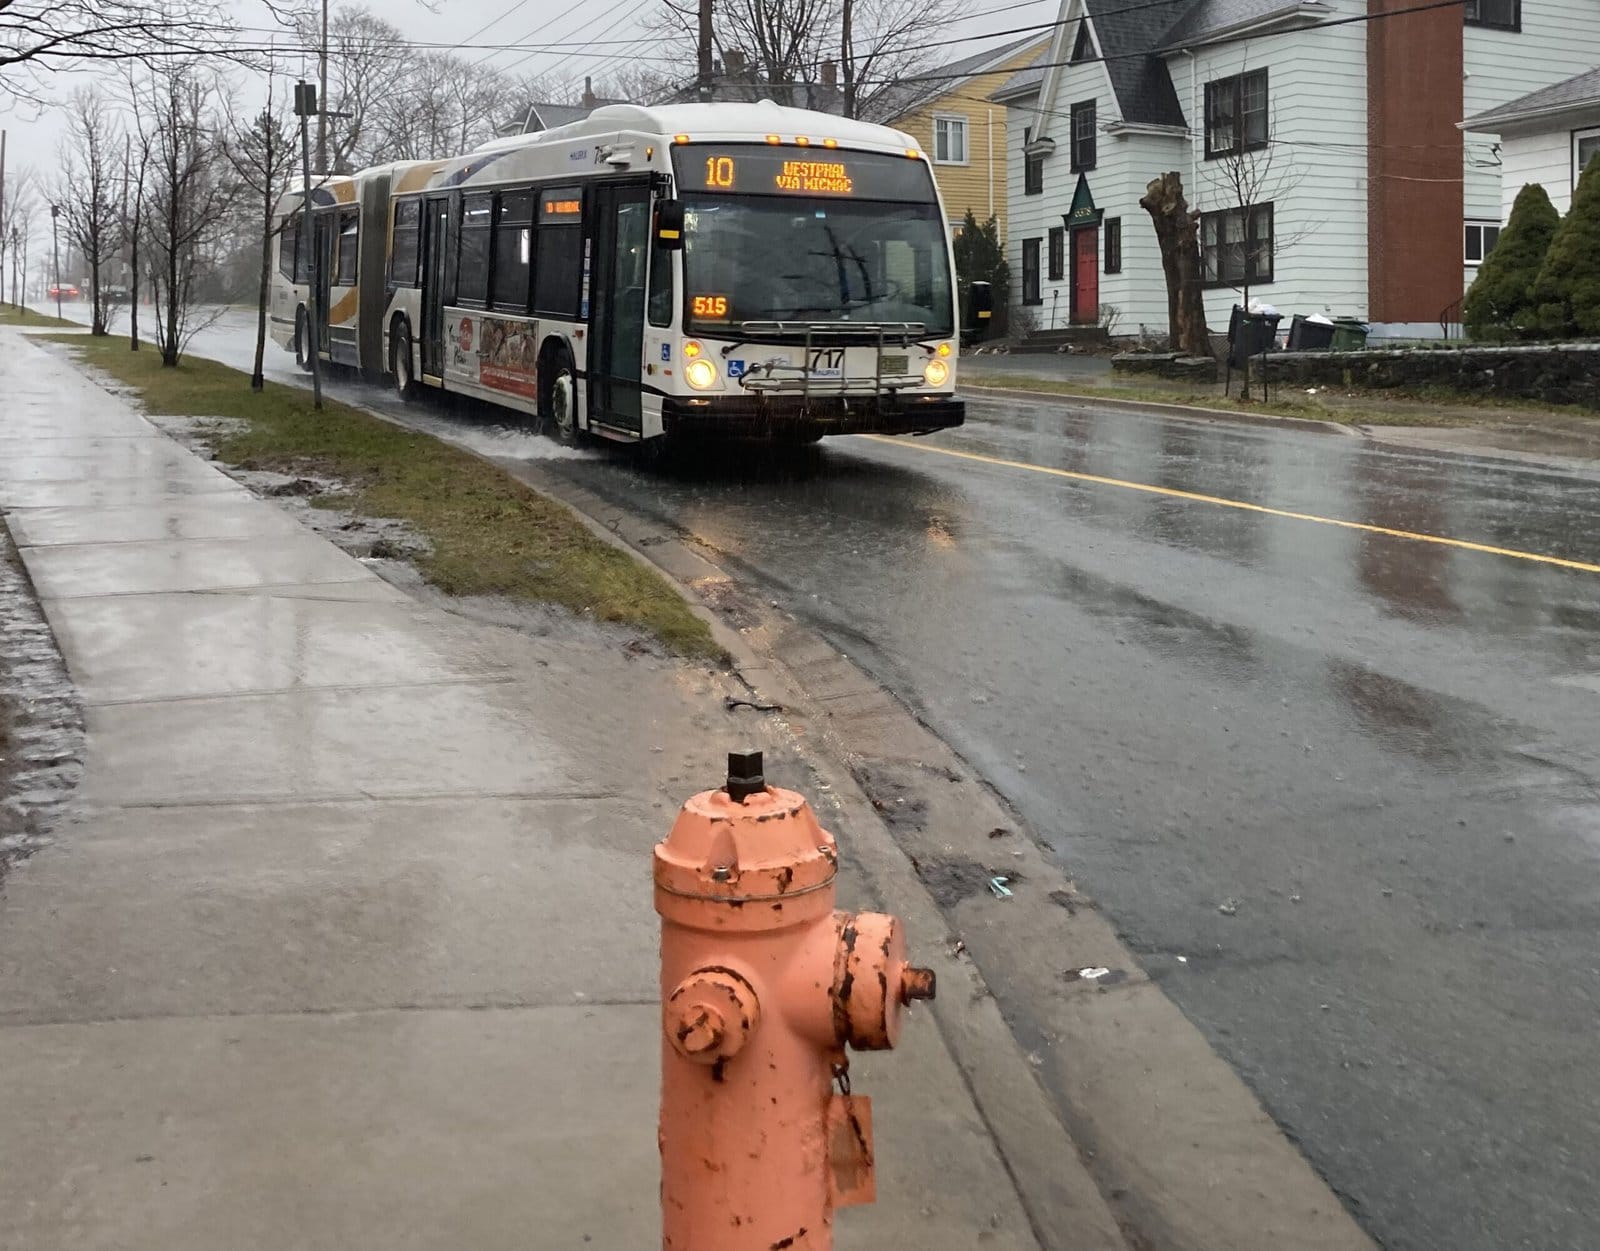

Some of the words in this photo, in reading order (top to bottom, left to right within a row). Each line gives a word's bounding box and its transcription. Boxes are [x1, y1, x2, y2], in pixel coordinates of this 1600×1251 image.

[705, 156, 735, 187] 10
[782, 161, 846, 178] WESTPHAL
[776, 175, 801, 191] VIA
[803, 177, 853, 193] MICMAC
[693, 296, 727, 315] 515
[809, 348, 845, 369] 717
